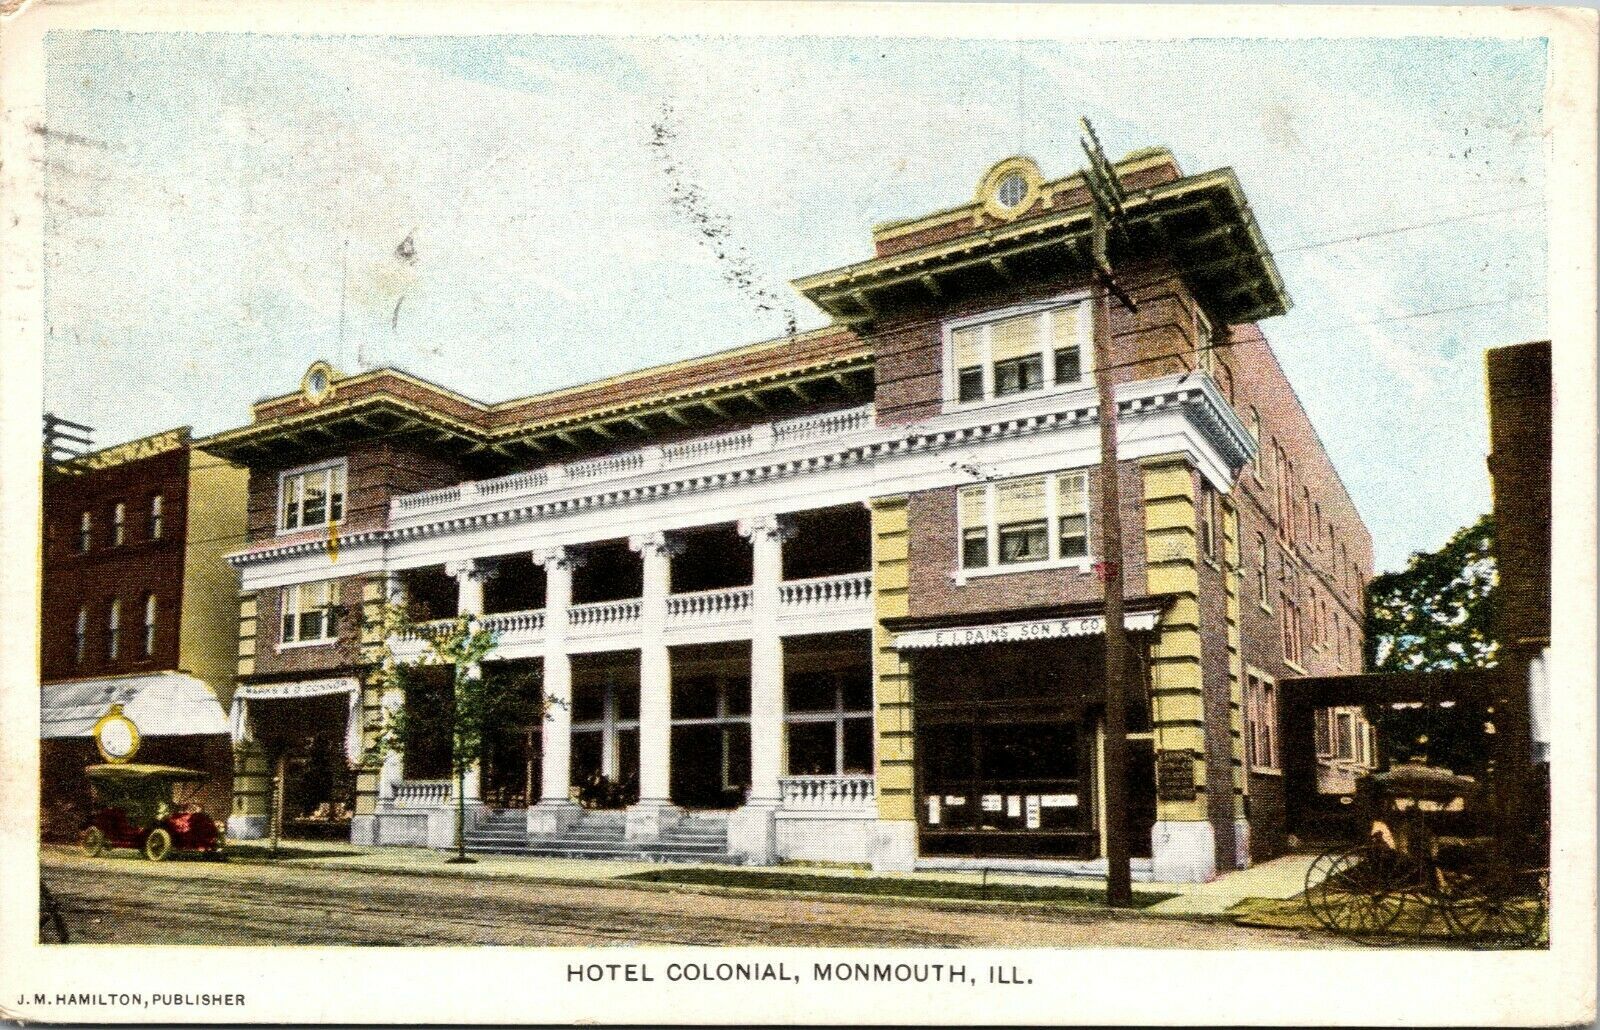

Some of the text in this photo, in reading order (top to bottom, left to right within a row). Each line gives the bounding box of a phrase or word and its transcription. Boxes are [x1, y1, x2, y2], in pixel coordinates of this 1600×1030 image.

[965, 625, 1009, 642] DAINS
[1021, 623, 1050, 637] SON
[1060, 620, 1070, 634] &
